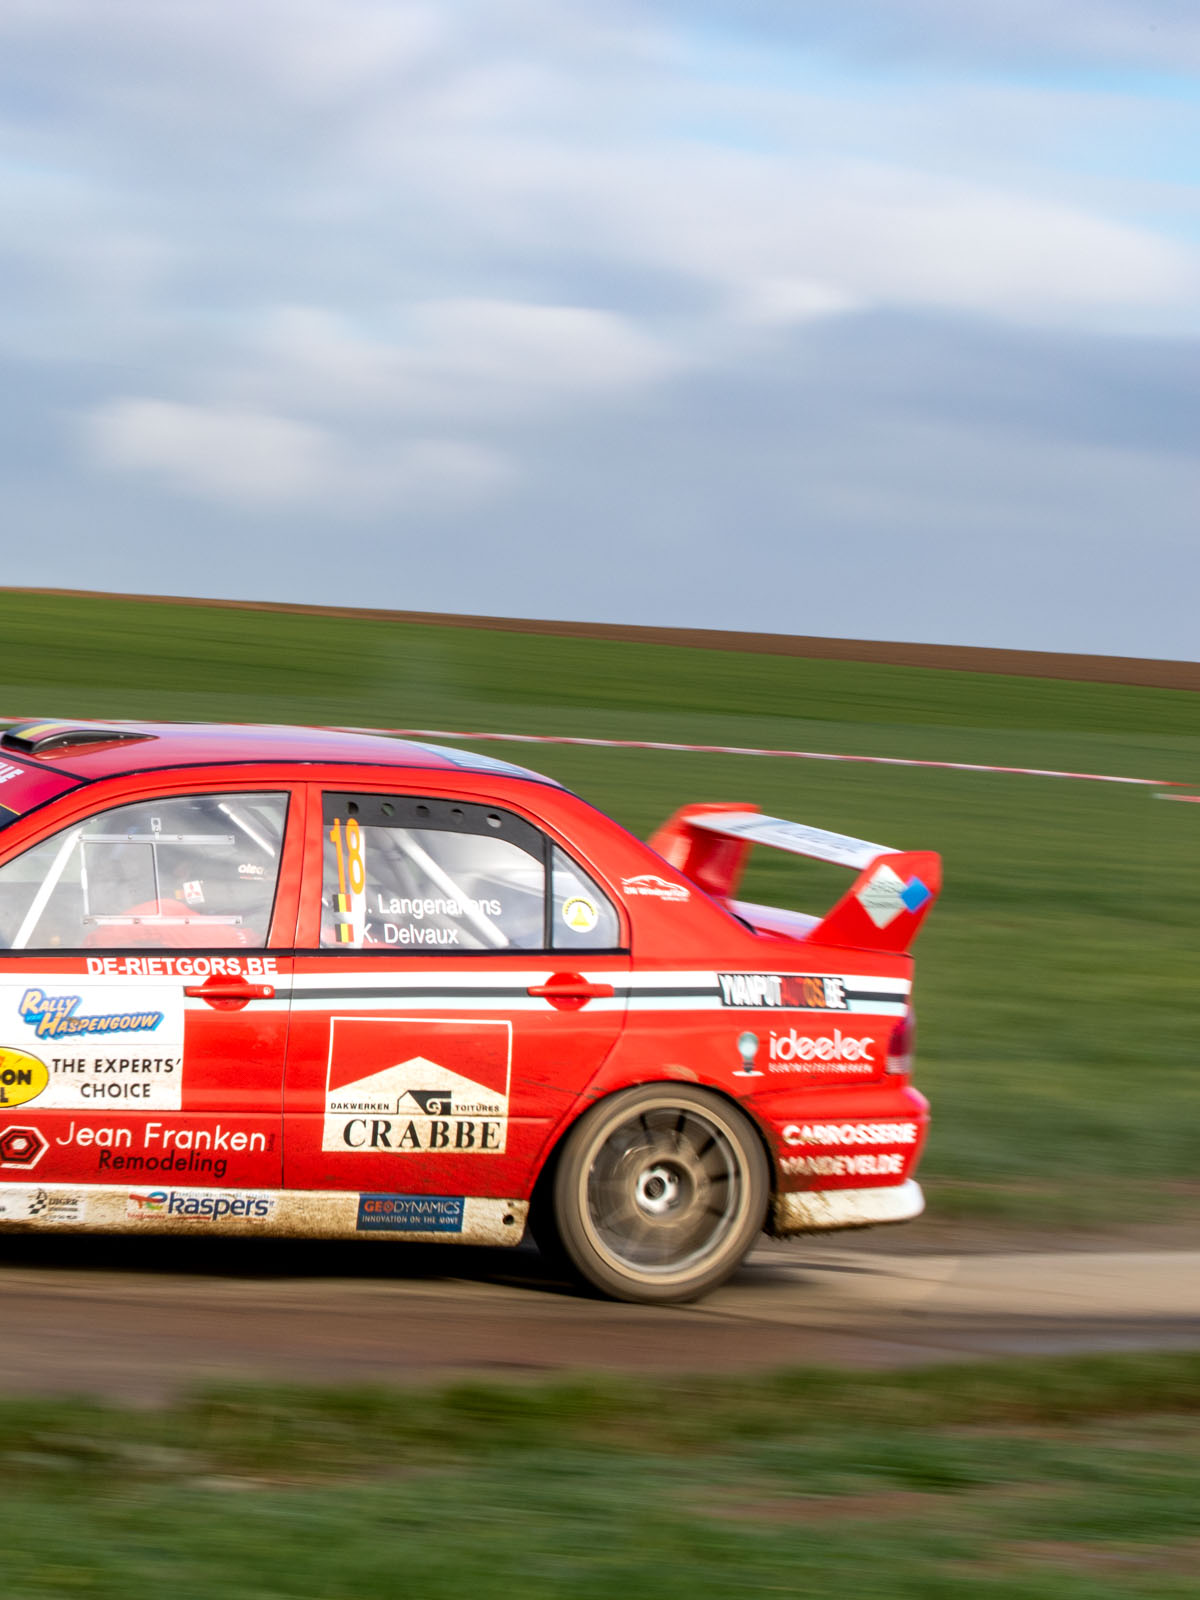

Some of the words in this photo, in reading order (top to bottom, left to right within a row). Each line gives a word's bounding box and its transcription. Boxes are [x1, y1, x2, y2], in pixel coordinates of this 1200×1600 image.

[330, 818, 365, 894] 18
[384, 923, 459, 944] Delvaux
[87, 957, 278, 976] DE-RIETGORS.BE
[769, 1027, 876, 1061] ideelec
[52, 1058, 86, 1073] THE
[80, 1083, 151, 1099] CHOICE
[330, 1102, 390, 1111] DAKWERKEN
[455, 1103, 500, 1113] TOITURES
[56, 1121, 132, 1148] Jean
[144, 1122, 266, 1152] Franken
[343, 1118, 501, 1150] CRABBE
[99, 1149, 228, 1178] Remodeling
[364, 1200, 461, 1215] GEODYNAMICS
[362, 1215, 408, 1224] INNOVATION
[410, 1215, 421, 1224] ON
[423, 1215, 436, 1224] THE
[439, 1216, 459, 1225] MOVE
